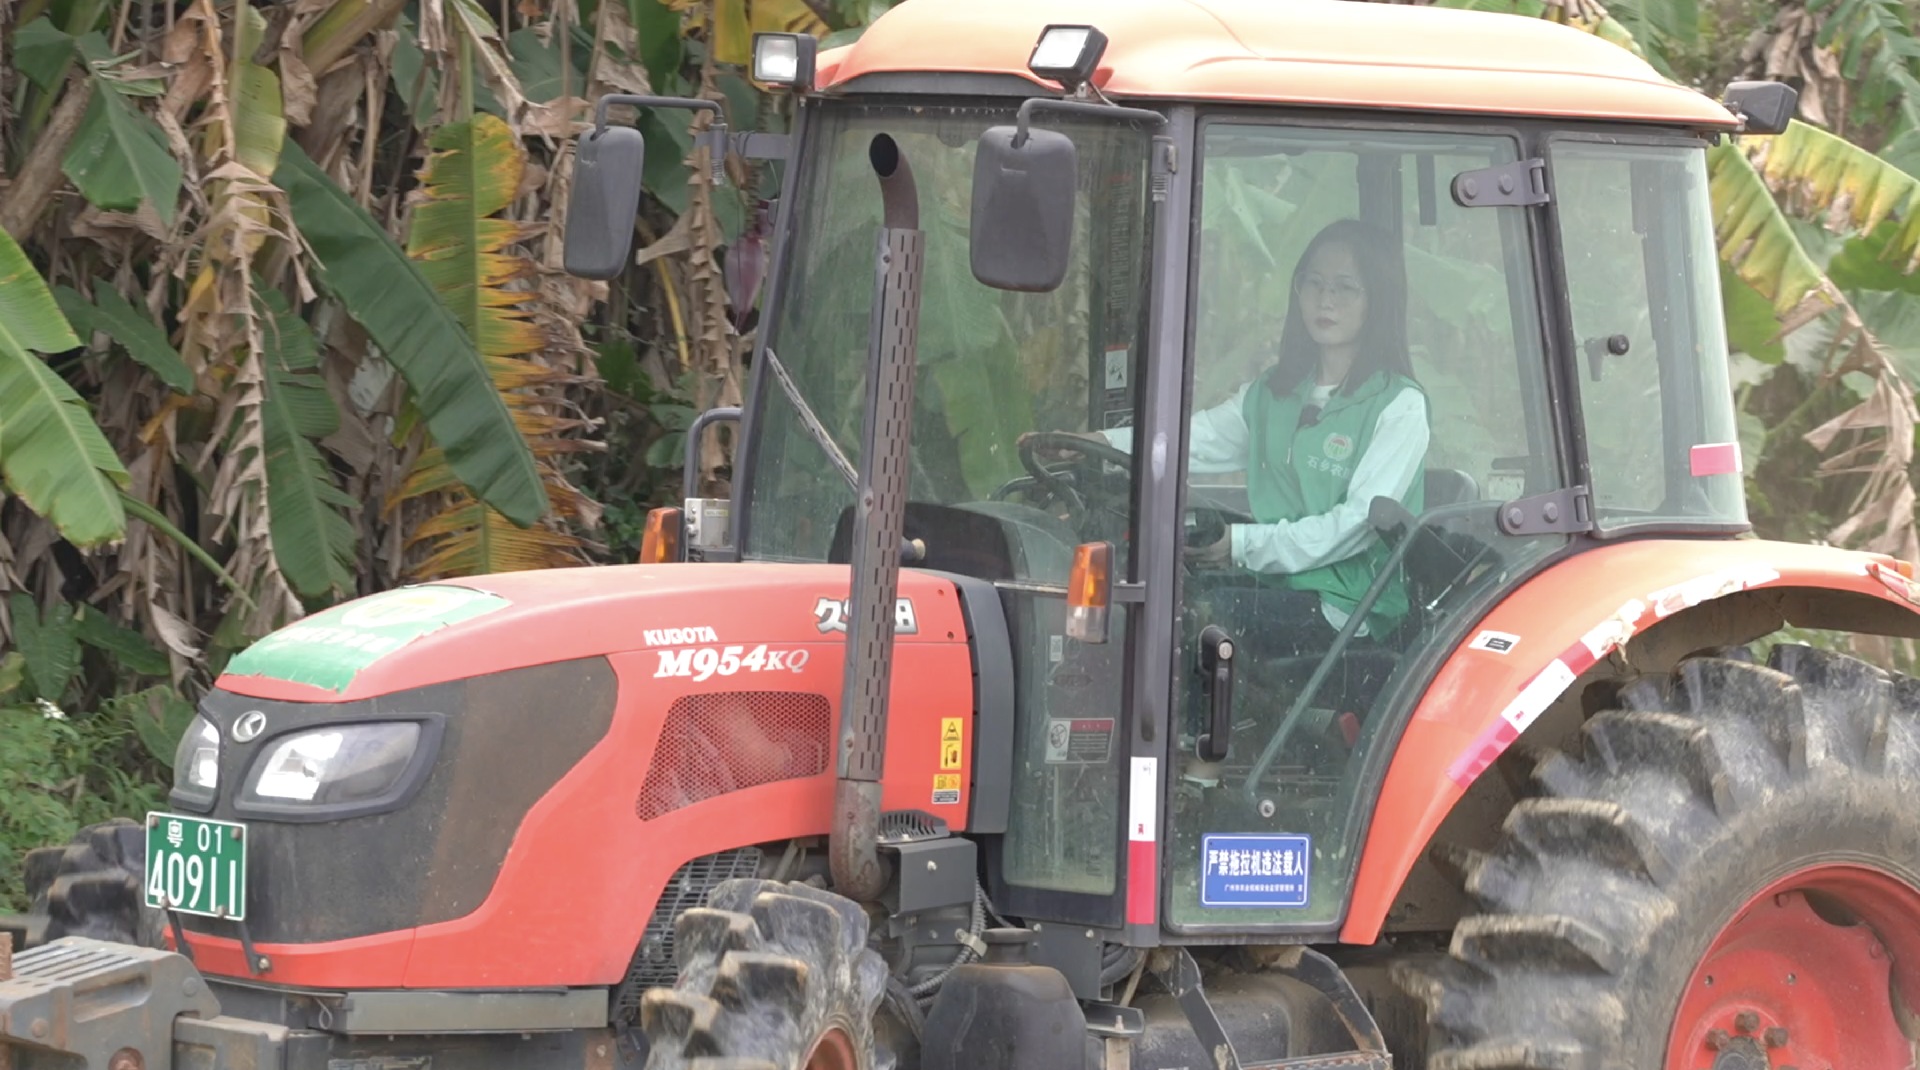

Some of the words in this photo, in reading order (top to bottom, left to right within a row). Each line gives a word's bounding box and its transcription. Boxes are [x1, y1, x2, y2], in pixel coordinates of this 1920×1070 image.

[814, 598, 918, 634] 久田
[643, 626, 718, 646] KUBOTA
[653, 644, 809, 682] M954KQ
[166, 820, 184, 848] 粤
[197, 823, 222, 854] 01
[1207, 849, 1304, 876] 严禁拖拉机违法载人
[148, 849, 237, 915] 40911
